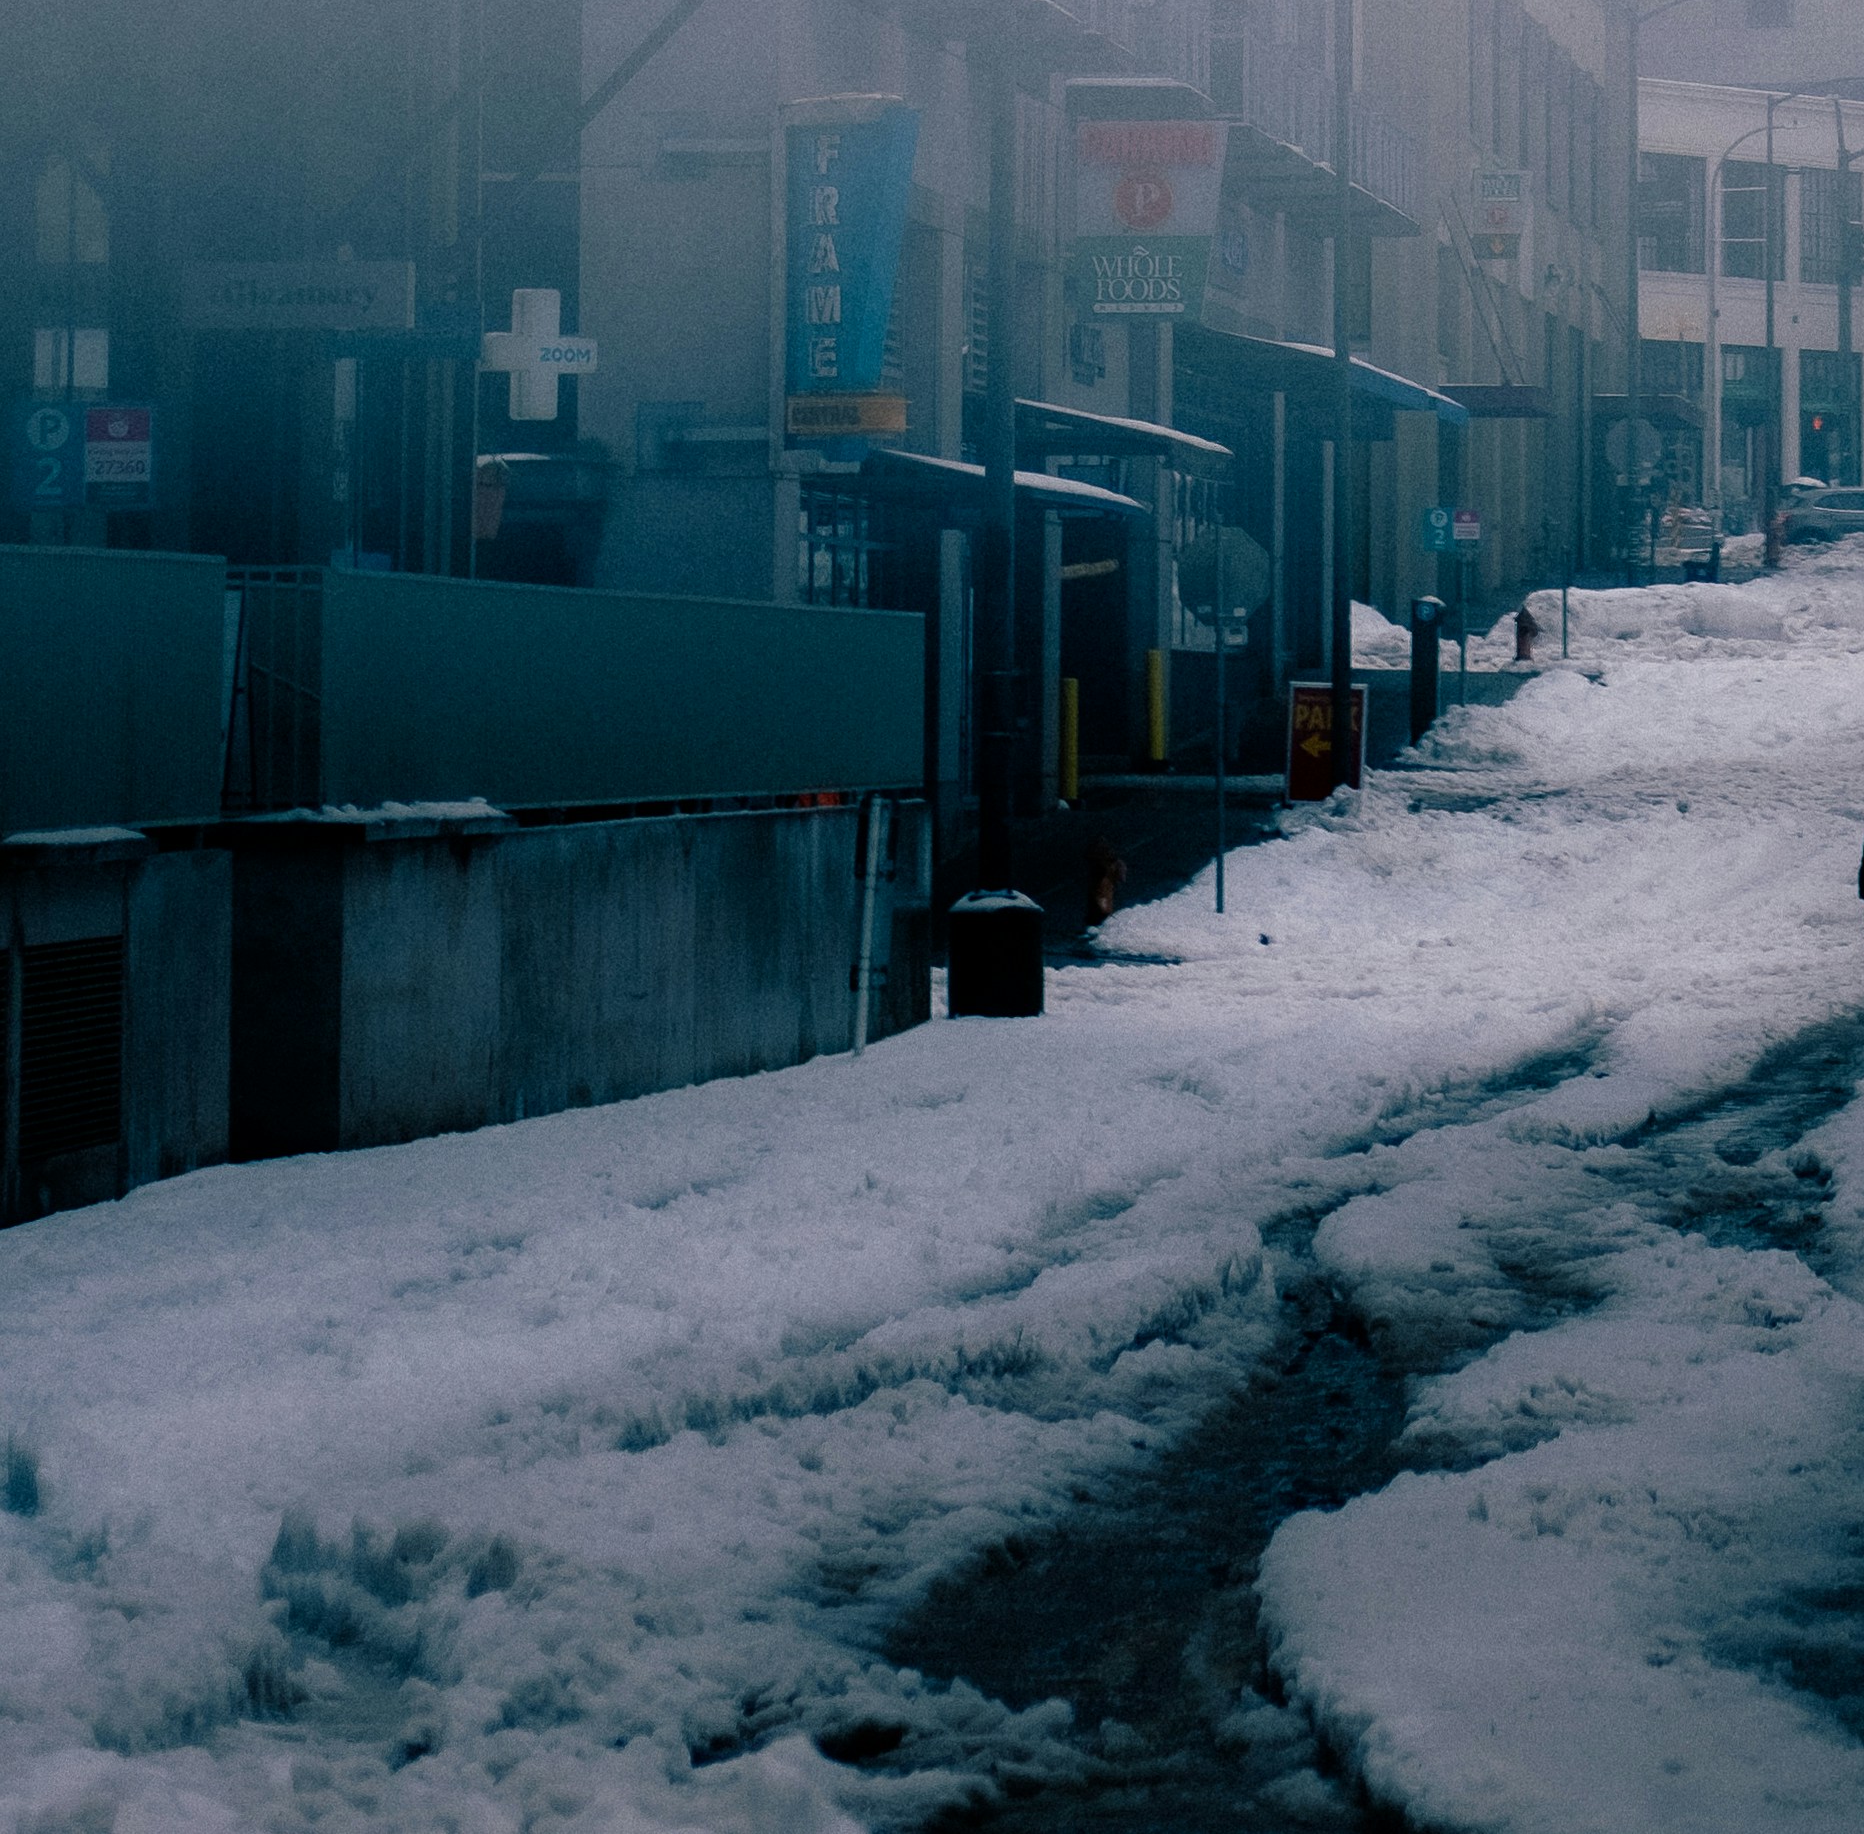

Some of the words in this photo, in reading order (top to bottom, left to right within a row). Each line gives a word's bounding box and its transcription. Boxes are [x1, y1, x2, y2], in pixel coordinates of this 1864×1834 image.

[807, 134, 841, 377] FRAME
[1091, 254, 1183, 278] WHOLE
[1096, 278, 1182, 301] FOODS
[540, 347, 591, 363] ZOOM
[35, 457, 63, 496] 2
[1295, 704, 1360, 732] PAK
